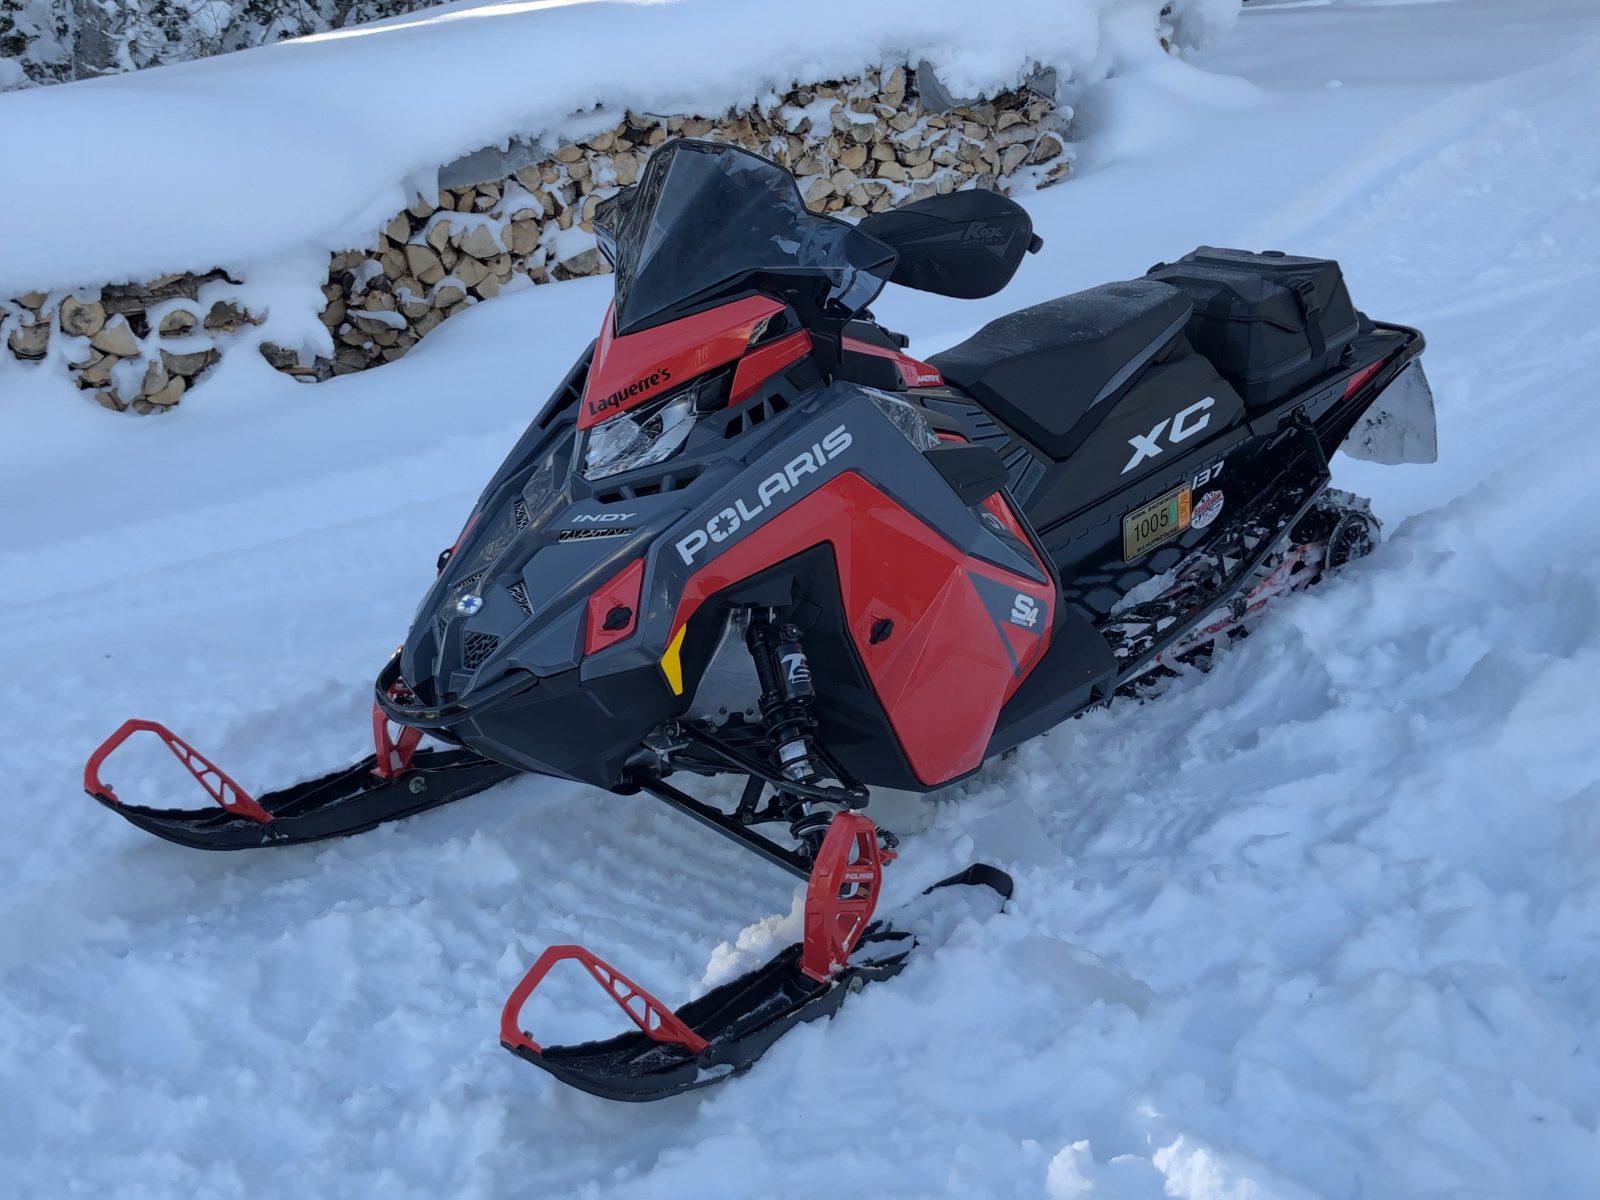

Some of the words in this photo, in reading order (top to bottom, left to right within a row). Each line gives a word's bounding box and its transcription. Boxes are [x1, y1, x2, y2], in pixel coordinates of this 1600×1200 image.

[588, 368, 671, 416] Laquerre's
[1120, 396, 1215, 475] XC
[1191, 460, 1224, 490] 137
[675, 424, 853, 566] POLARIS
[571, 512, 637, 523] INDY
[1134, 508, 1168, 542] 1005
[844, 872, 874, 880] POLARIS
